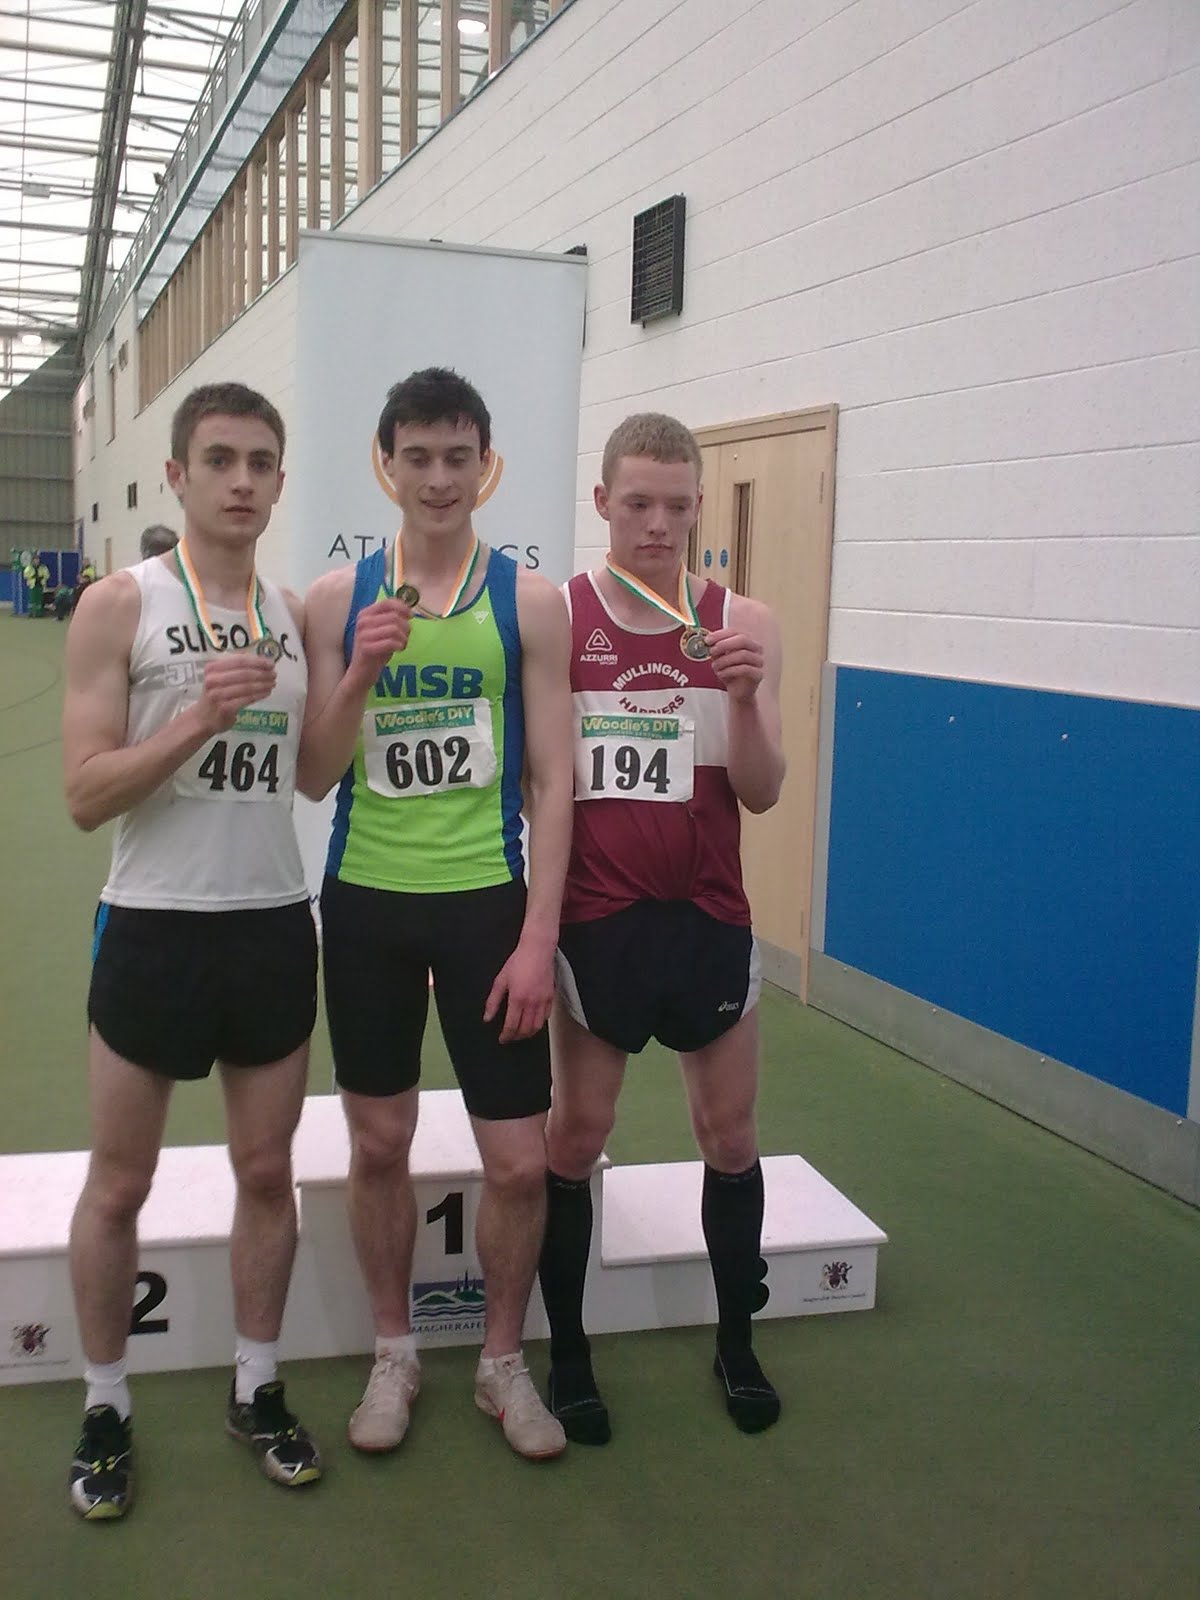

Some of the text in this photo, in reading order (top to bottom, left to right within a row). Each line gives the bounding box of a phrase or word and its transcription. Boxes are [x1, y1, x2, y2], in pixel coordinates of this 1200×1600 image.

[166, 623, 249, 655] SLIGO
[580, 654, 618, 662] AZZURRI
[375, 664, 483, 699] MSB
[612, 663, 689, 690] MULLINGAR
[376, 710, 445, 728] Woodie's
[447, 706, 473, 720] DIY
[583, 717, 678, 732] Woodie's DIY
[198, 740, 279, 793] 464
[386, 736, 472, 790] 602
[591, 745, 670, 794] 194
[426, 1192, 463, 1255] 1
[129, 1271, 169, 1336] 2
